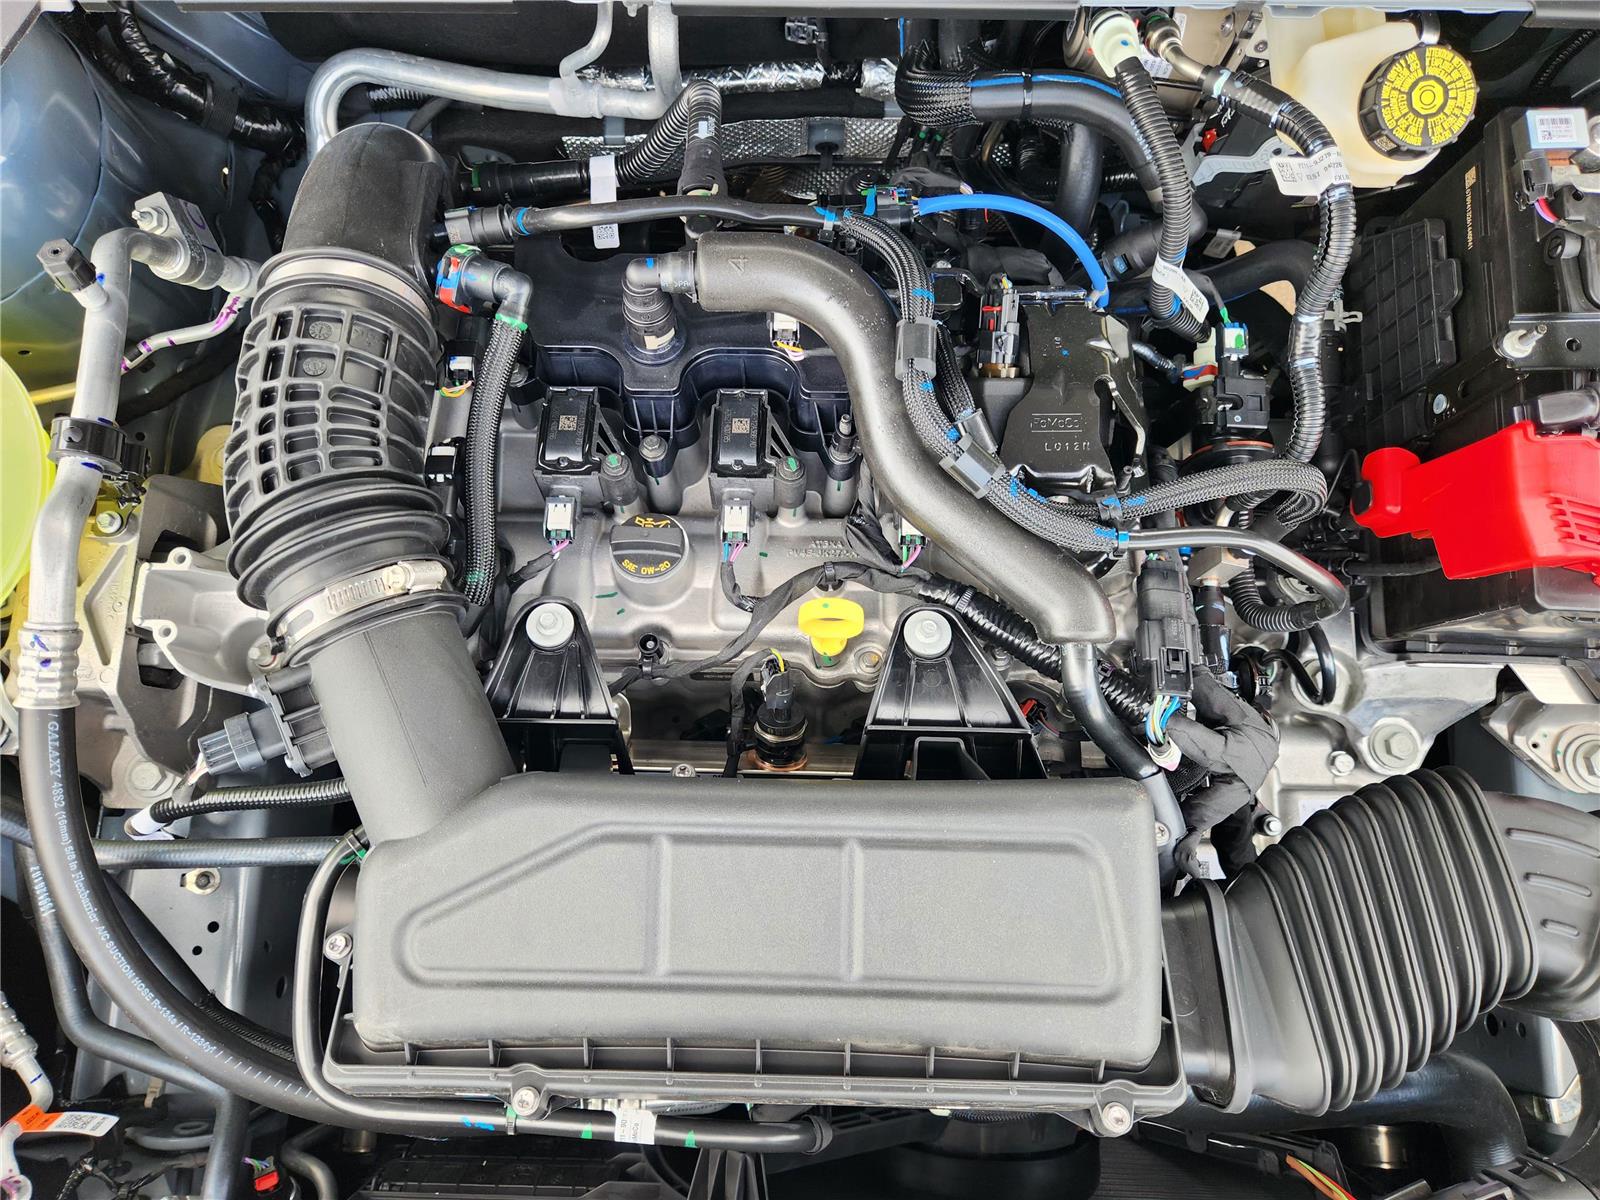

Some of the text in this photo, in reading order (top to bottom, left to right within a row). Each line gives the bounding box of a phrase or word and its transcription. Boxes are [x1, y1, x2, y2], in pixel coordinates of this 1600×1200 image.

[622, 559, 638, 573] SAE
[48, 721, 62, 779] GALAXY
[106, 941, 136, 980] SUCTION
[132, 976, 155, 1001] HOSE
